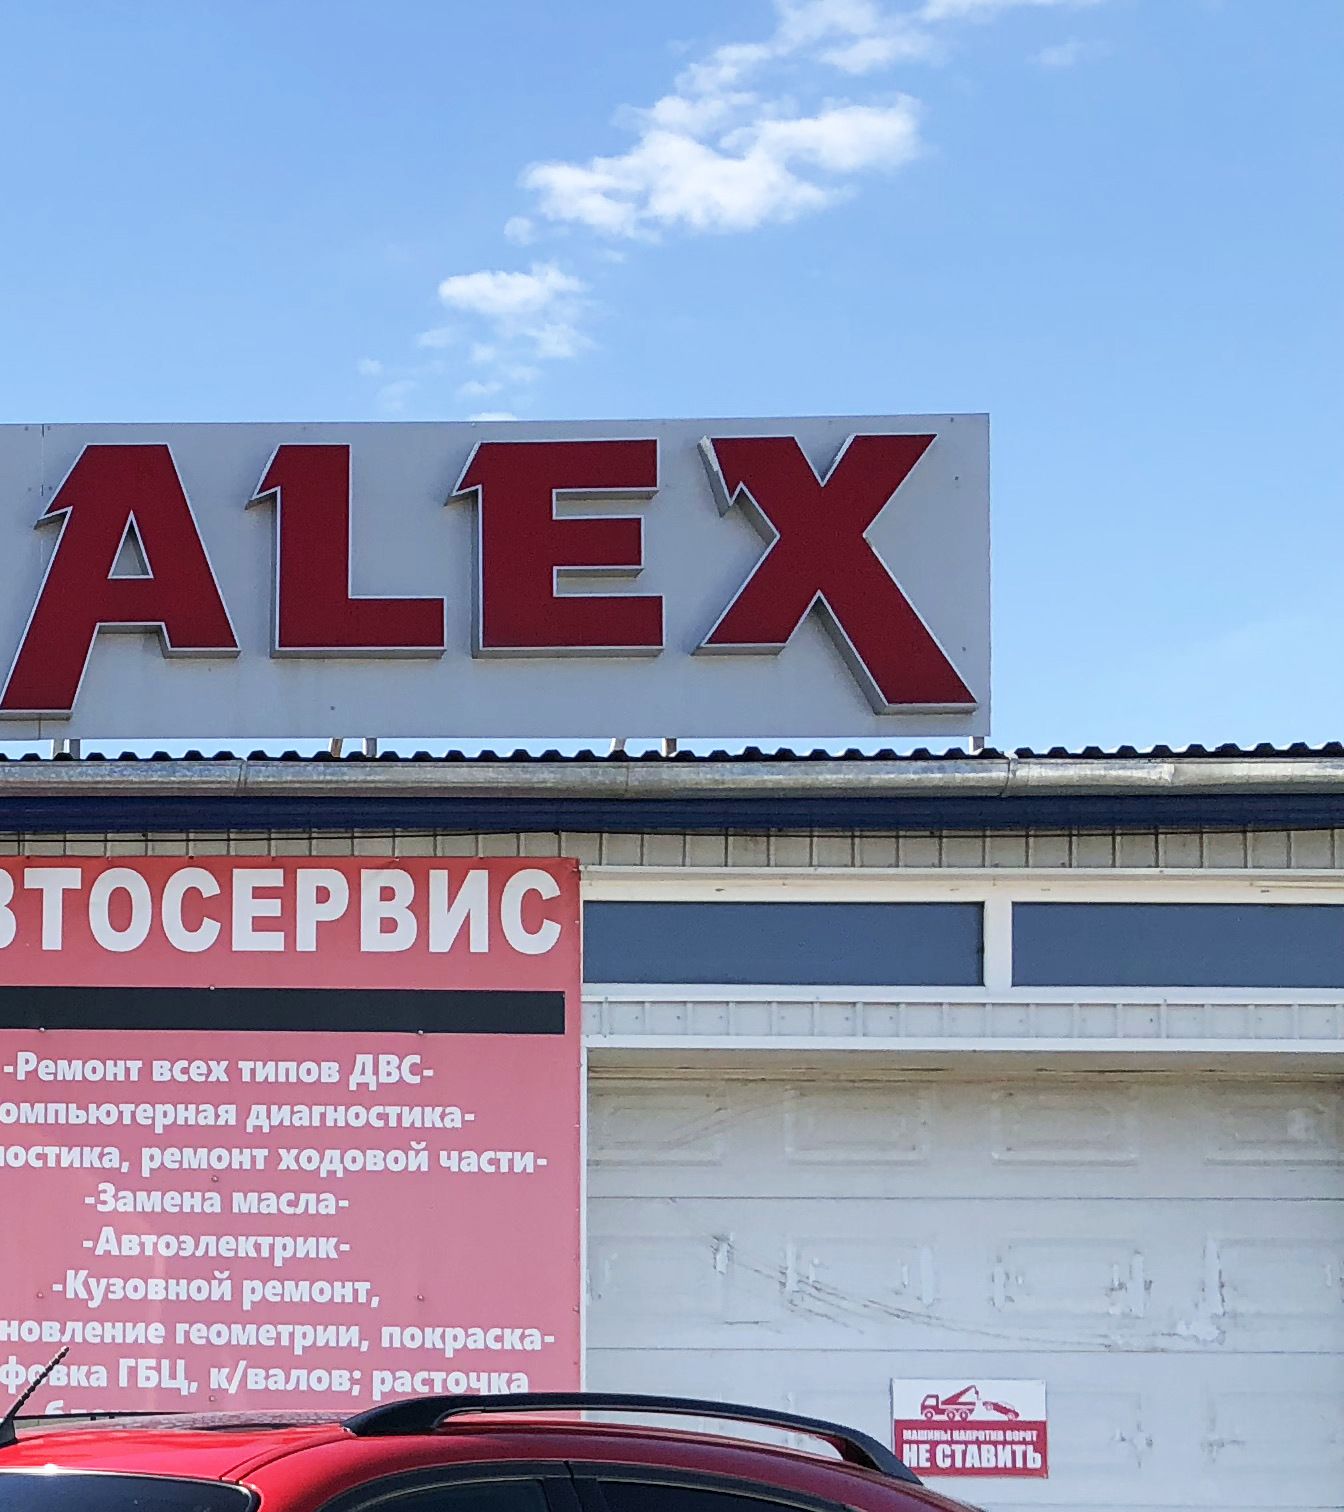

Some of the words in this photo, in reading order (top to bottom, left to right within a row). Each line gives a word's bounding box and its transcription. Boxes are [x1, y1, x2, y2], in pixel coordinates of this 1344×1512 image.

[152, 1059, 229, 1083] всех
[238, 1060, 340, 1084] типов
[141, 1147, 269, 1178] ремонт
[277, 1141, 429, 1177] ходовой
[242, 1279, 381, 1310] ремонт,
[175, 1322, 369, 1355] геометрии,
[118, 1358, 199, 1395] ГБЦ,
[209, 1360, 363, 1395] к/валов;
[372, 1370, 529, 1398] расточка
[902, 1443, 931, 1468] НЕ
[935, 1443, 1042, 1469] СТАВИТЬ
